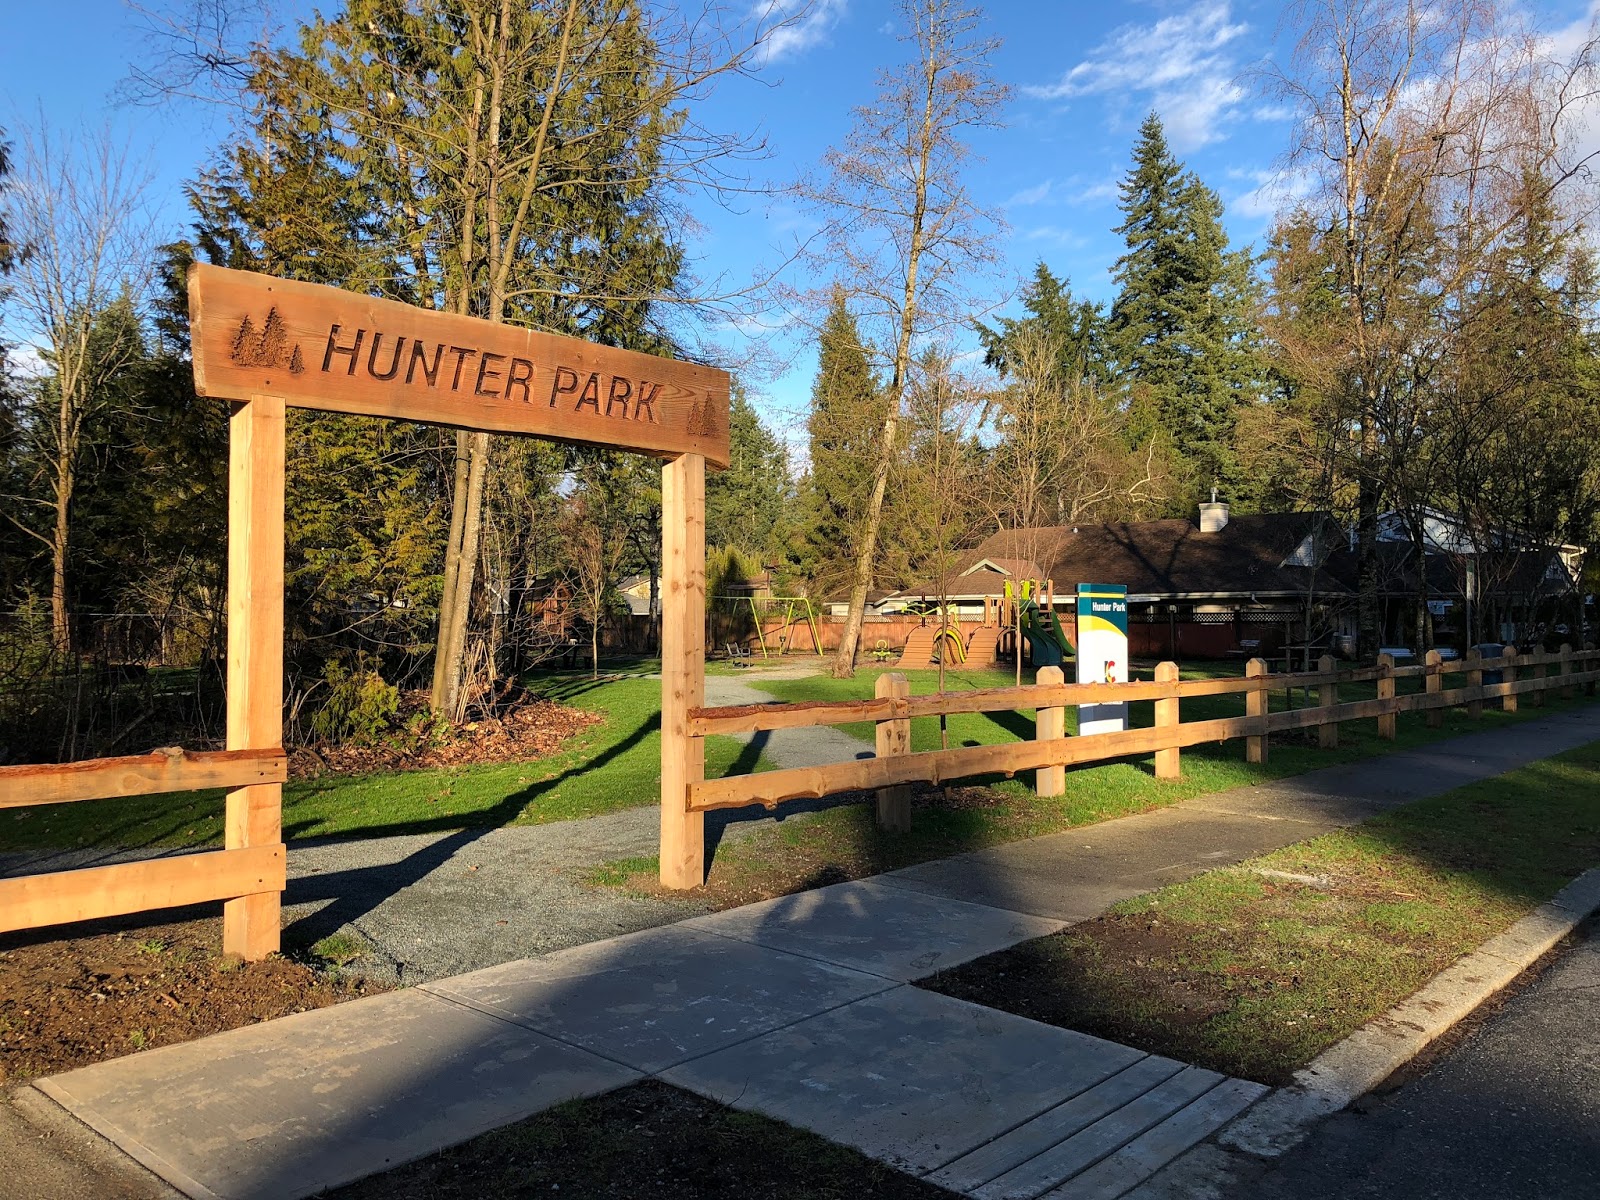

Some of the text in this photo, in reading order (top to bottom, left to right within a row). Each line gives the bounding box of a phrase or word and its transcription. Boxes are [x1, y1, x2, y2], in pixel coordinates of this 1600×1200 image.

[321, 324, 665, 424] HUNTER PARK
[1092, 602, 1126, 611] Hunter Park
